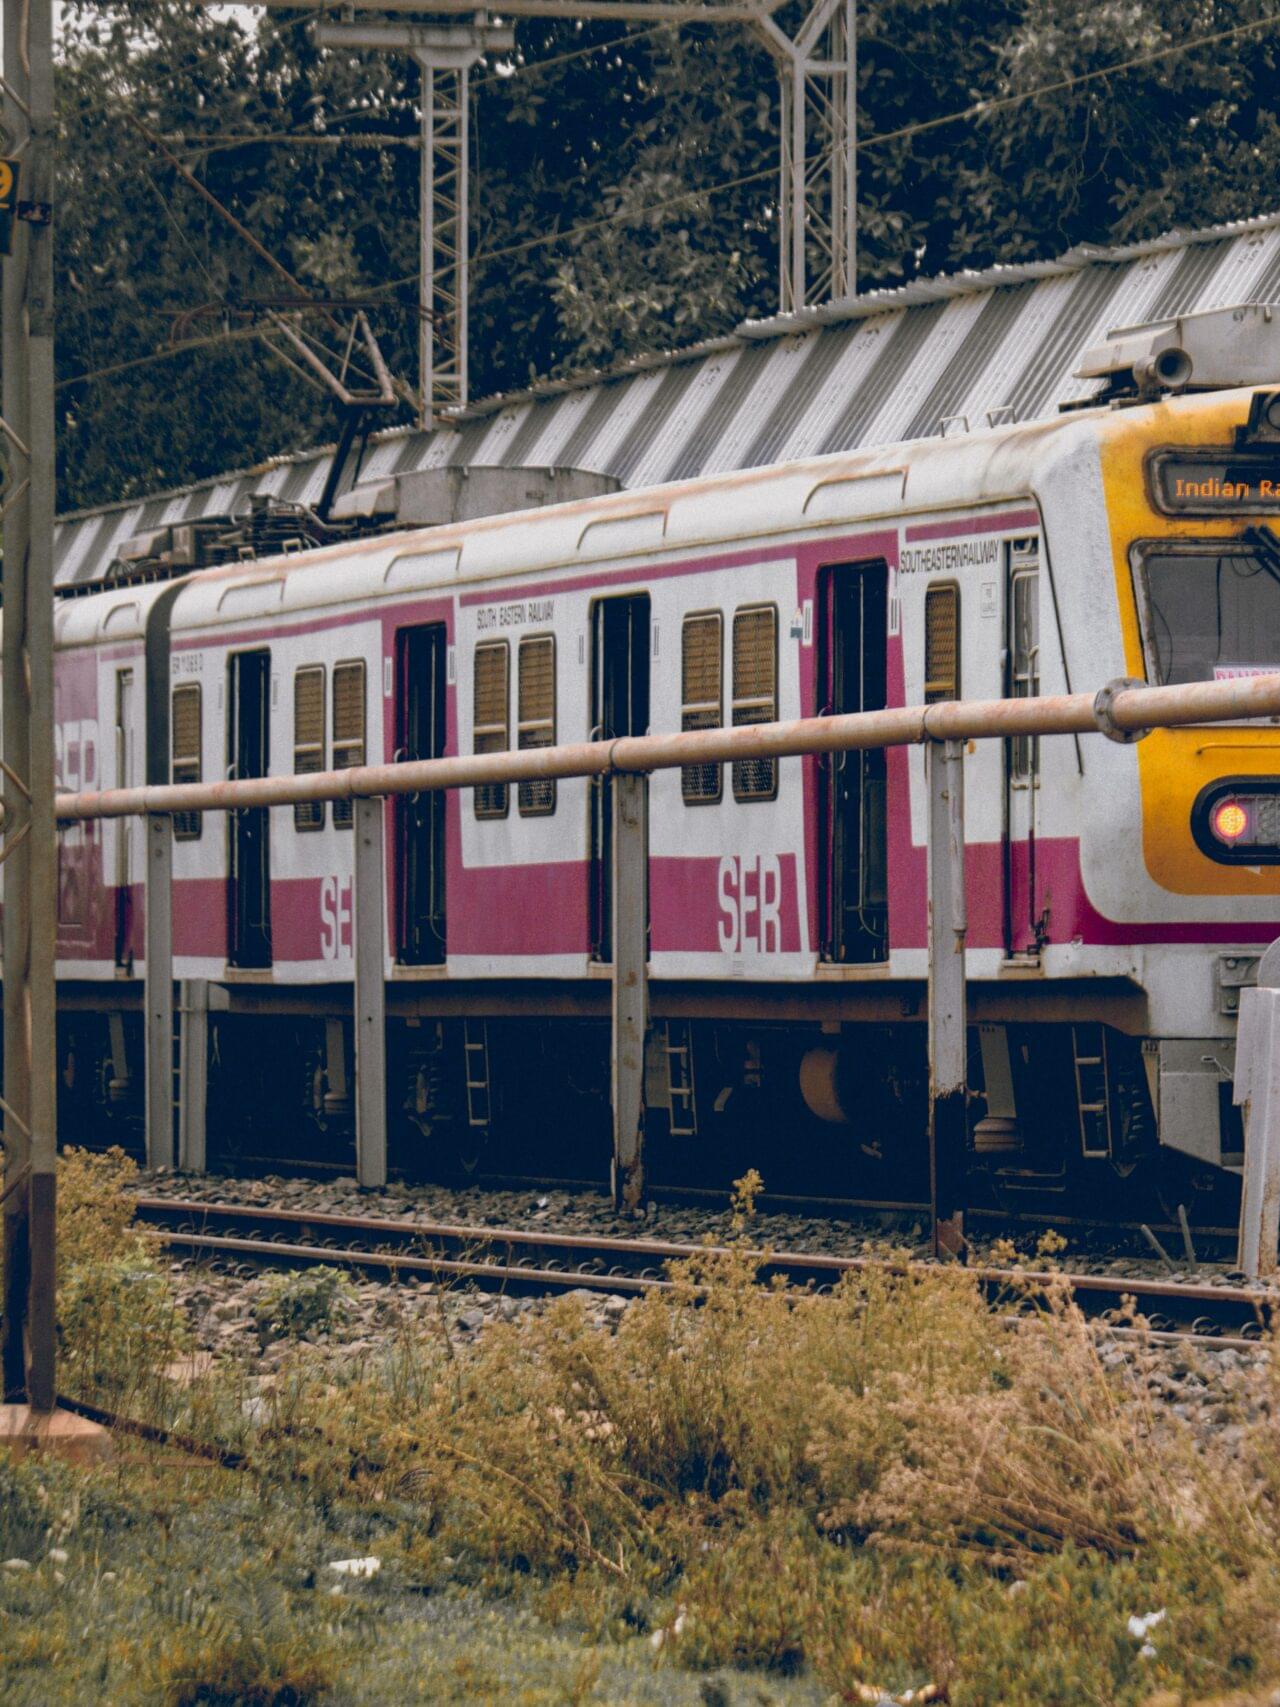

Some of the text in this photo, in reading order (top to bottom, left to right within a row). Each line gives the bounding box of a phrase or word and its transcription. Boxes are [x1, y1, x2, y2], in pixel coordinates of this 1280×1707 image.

[1176, 477, 1249, 497] Indian
[477, 600, 555, 630] SOUTH EASTERN RAILWAY
[321, 876, 356, 960] SE
[719, 854, 781, 954] SER
